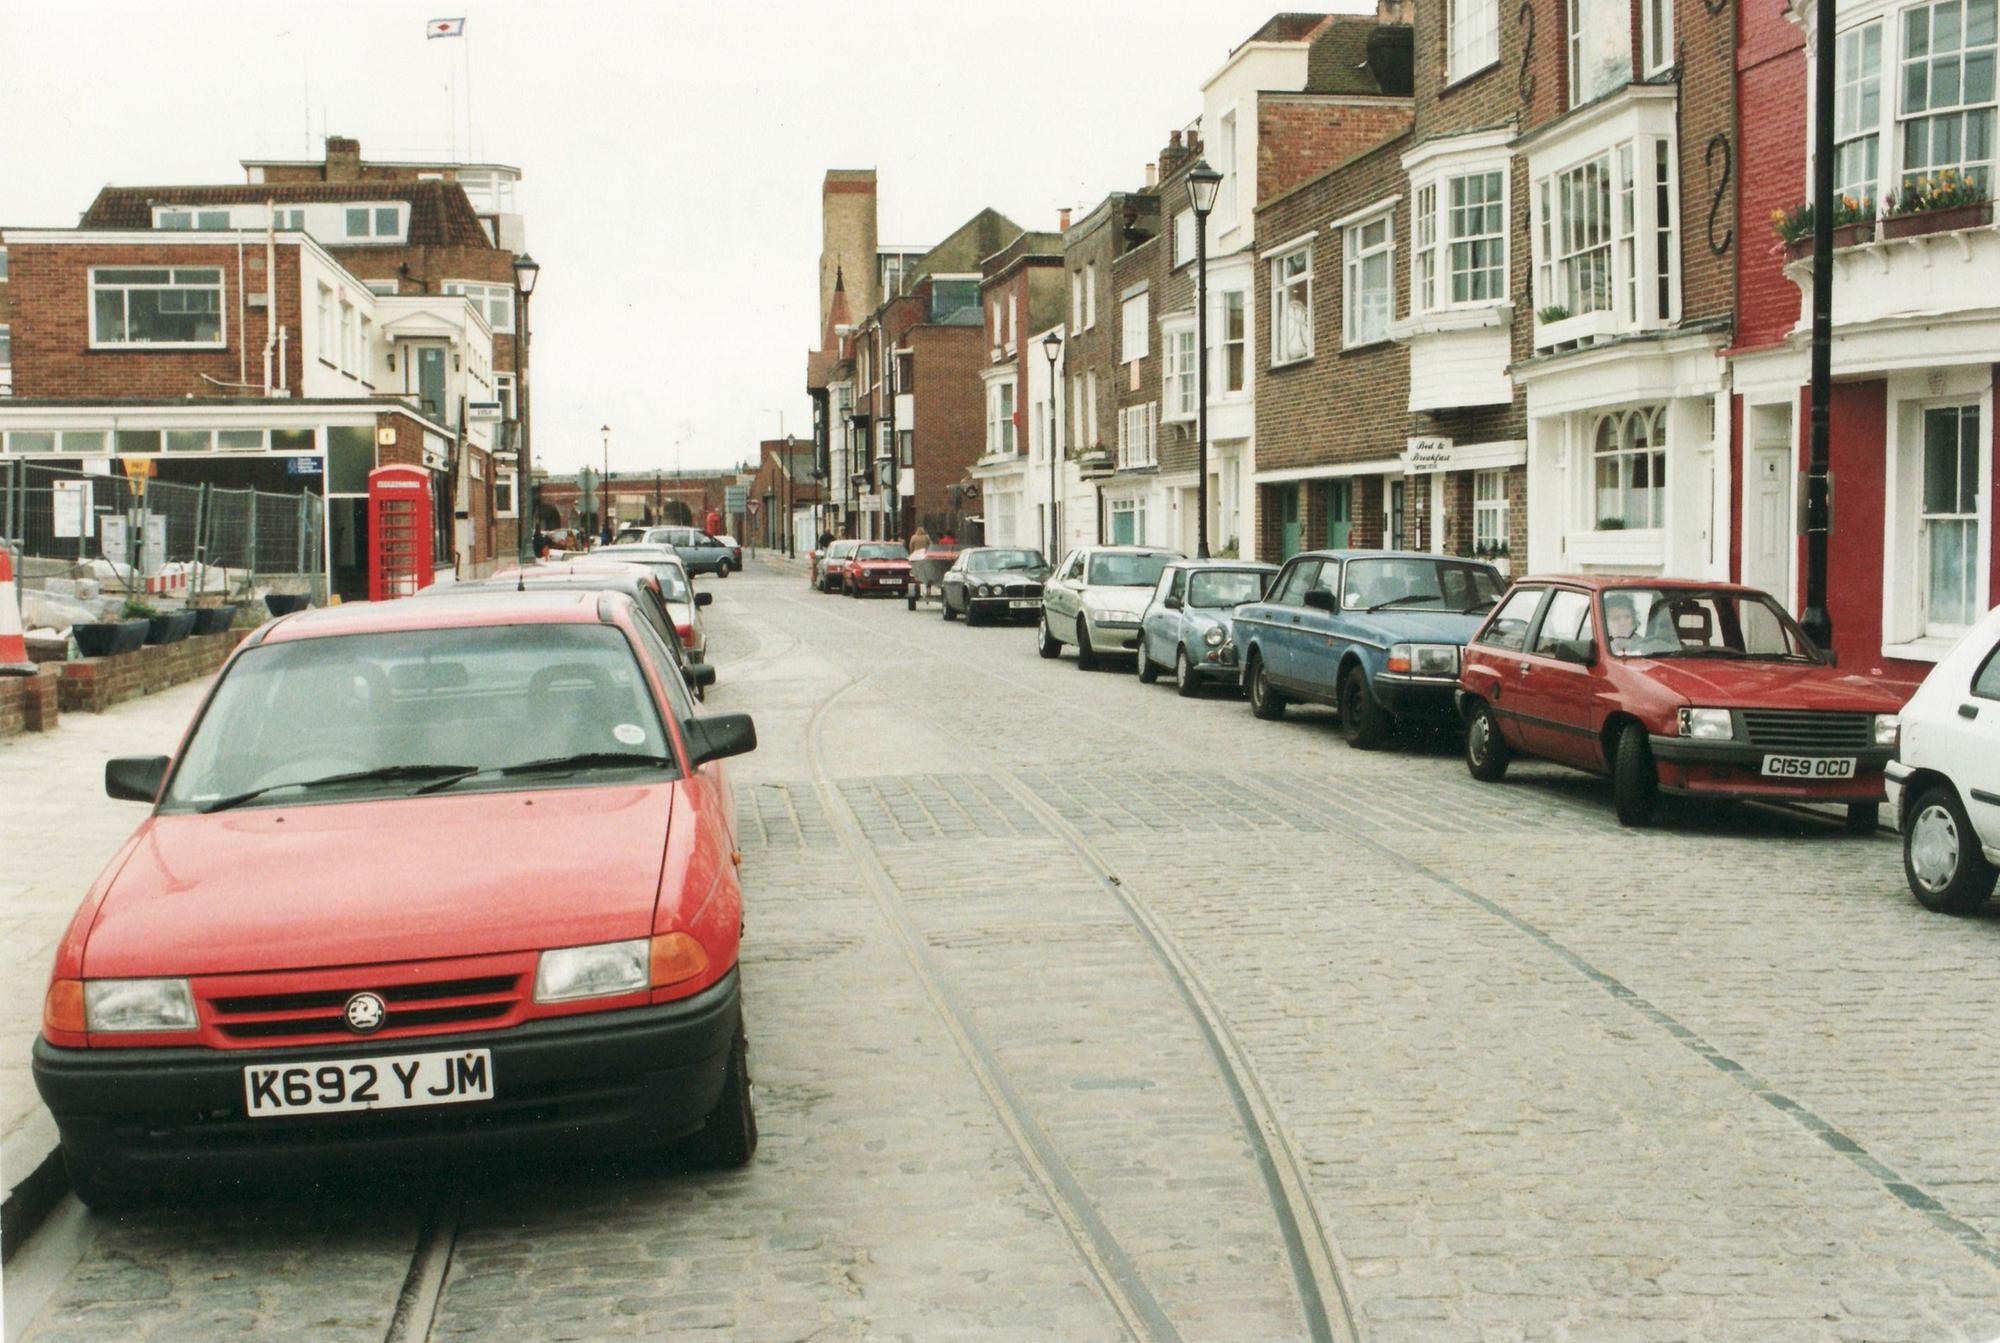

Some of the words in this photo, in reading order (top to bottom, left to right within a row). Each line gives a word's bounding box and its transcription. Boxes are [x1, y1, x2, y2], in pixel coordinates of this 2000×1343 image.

[1416, 441, 1434, 450] Bed
[1410, 452, 1451, 464] Breakfast
[1768, 757, 1812, 775] C159
[1815, 759, 1850, 776] OCD
[250, 1063, 380, 1109] K692
[391, 1055, 488, 1099] YJM
